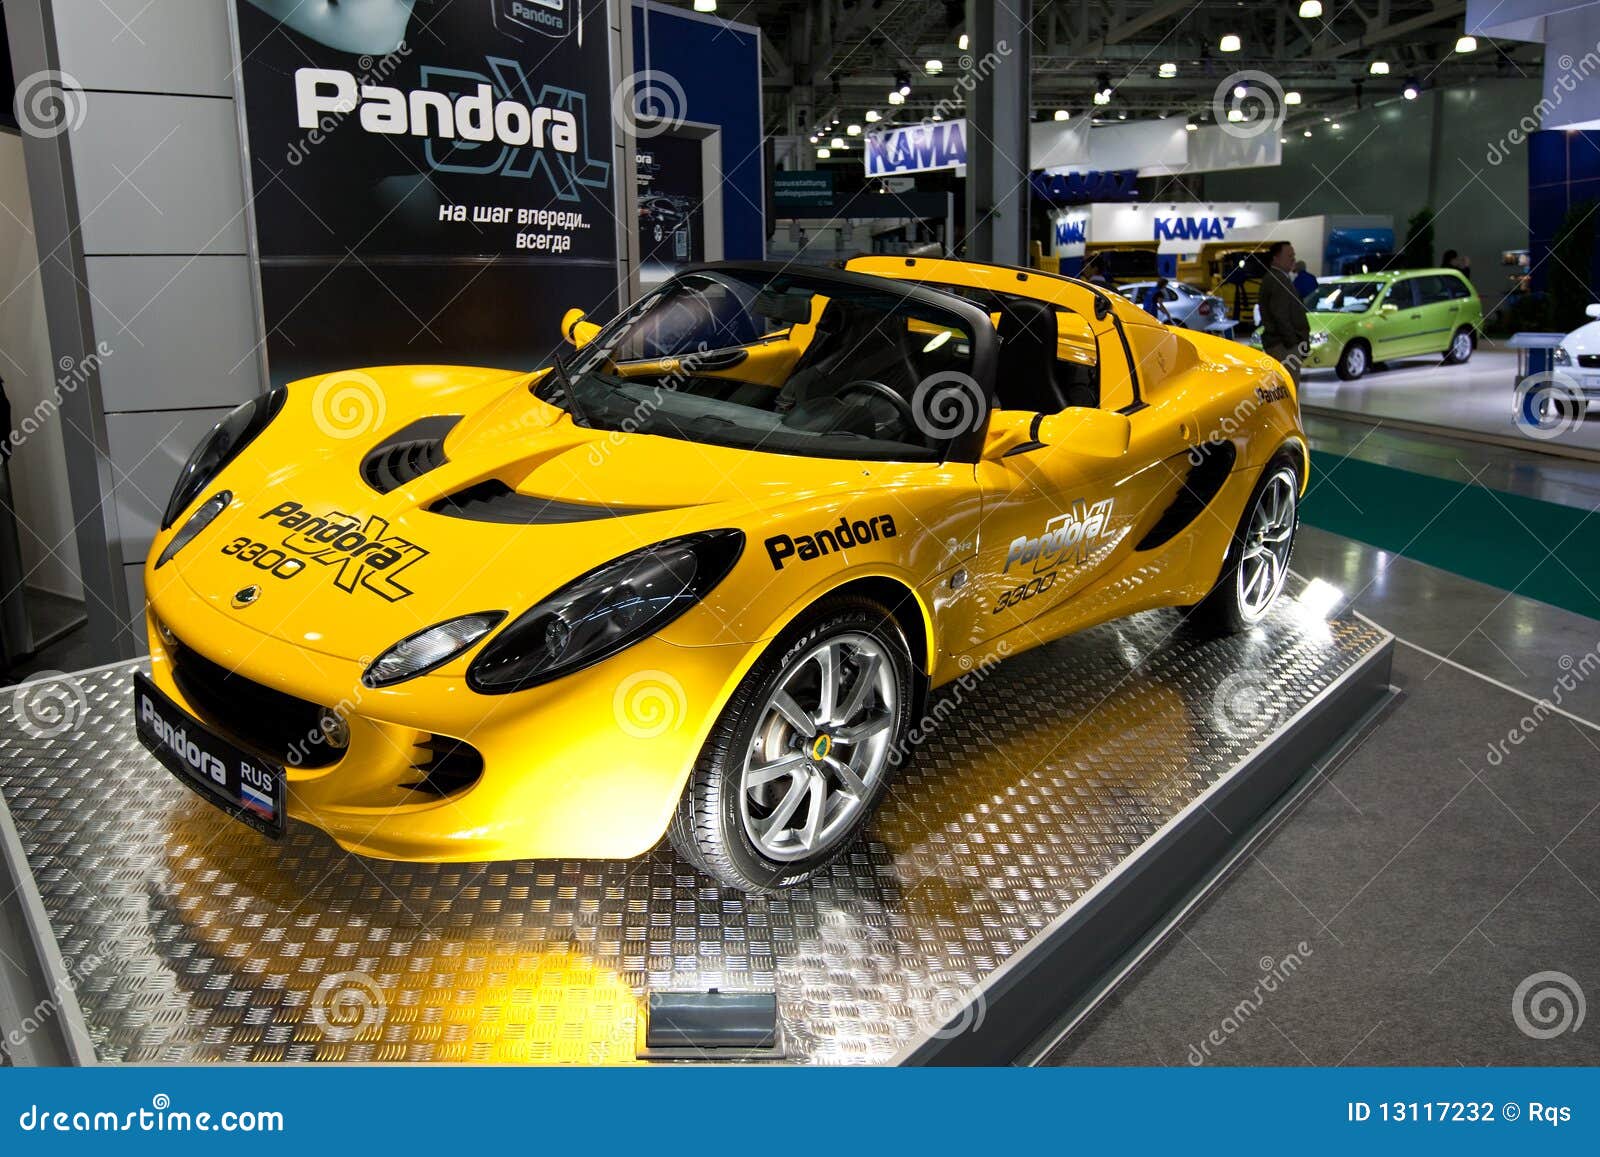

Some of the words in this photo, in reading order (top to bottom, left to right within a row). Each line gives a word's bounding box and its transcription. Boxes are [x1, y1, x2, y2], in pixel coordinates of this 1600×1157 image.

[512, 2, 564, 29] Pandora
[295, 68, 578, 153] Pandora
[438, 205, 467, 222] на
[473, 206, 514, 223] шаг
[517, 209, 590, 230] впереди...
[1056, 220, 1086, 246] KAMAZ
[516, 233, 571, 253] всегда
[258, 501, 402, 571] Pandora
[764, 514, 896, 571] Pandora
[1002, 513, 1104, 575] Pandora
[221, 537, 306, 580] 3300
[993, 571, 1057, 614] 3300
[142, 694, 226, 785] Pandora
[241, 761, 272, 792] RUS
